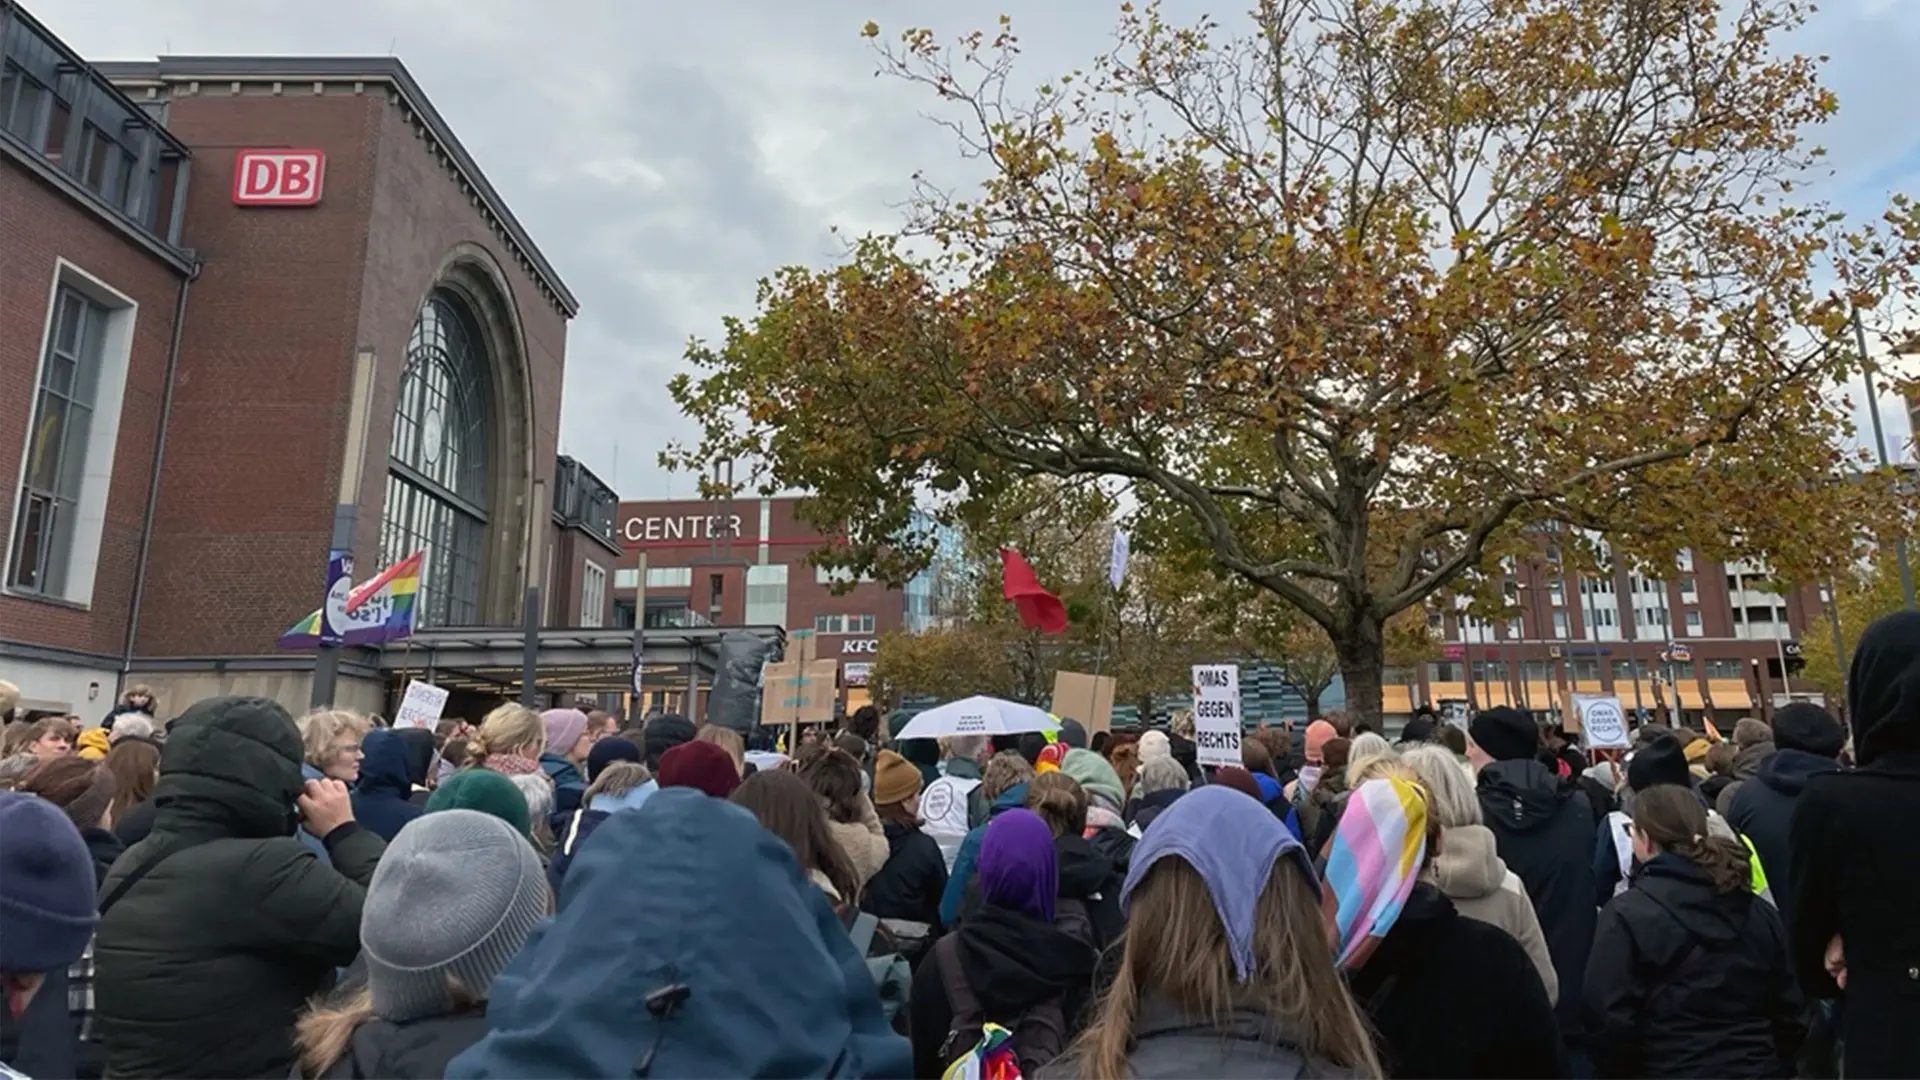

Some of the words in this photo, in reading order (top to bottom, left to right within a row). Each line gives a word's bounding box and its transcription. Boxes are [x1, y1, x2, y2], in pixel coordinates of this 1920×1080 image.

[245, 159, 310, 195] DB
[842, 639, 879, 653] KFC
[1198, 670, 1229, 687] OMAS
[1197, 701, 1234, 718] GEGEN
[1197, 731, 1239, 749] RECHTS
